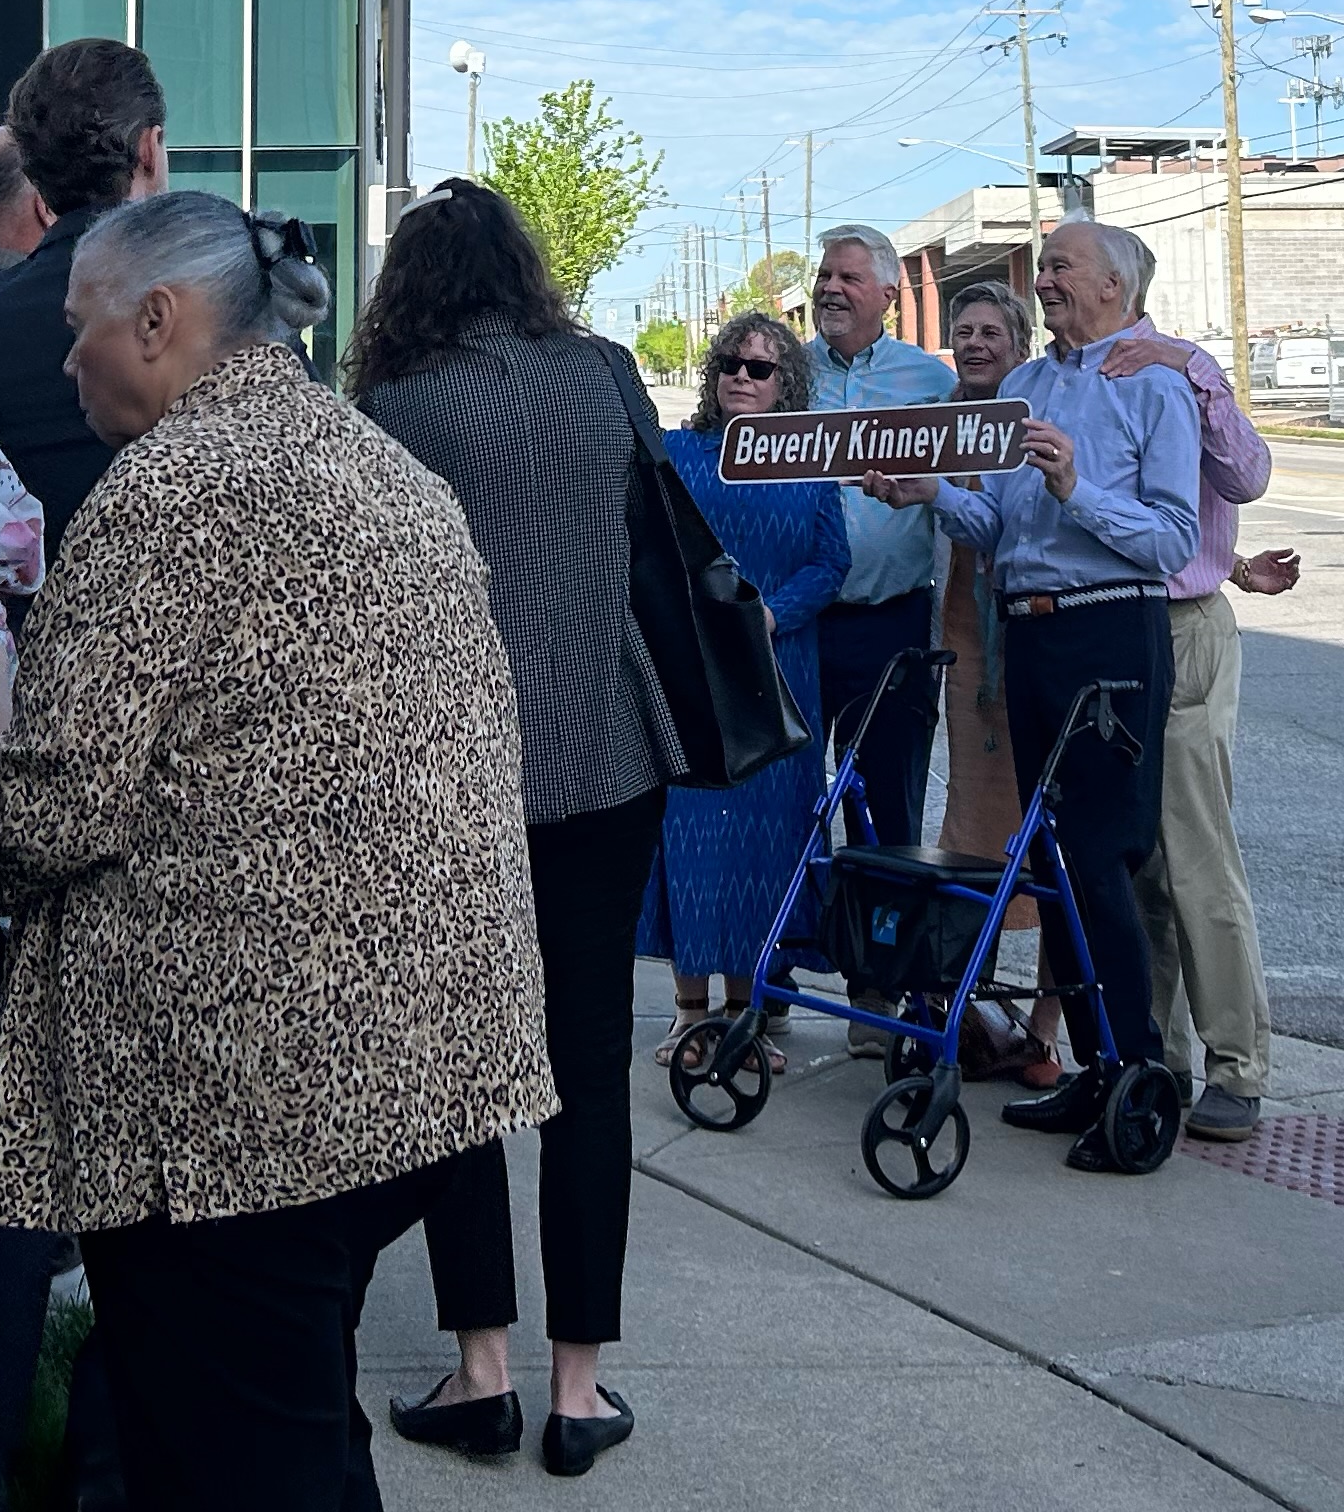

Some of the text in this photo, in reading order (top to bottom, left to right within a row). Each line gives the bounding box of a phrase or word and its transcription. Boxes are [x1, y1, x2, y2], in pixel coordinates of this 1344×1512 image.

[735, 414, 1016, 471] Beverly Kinney Way
